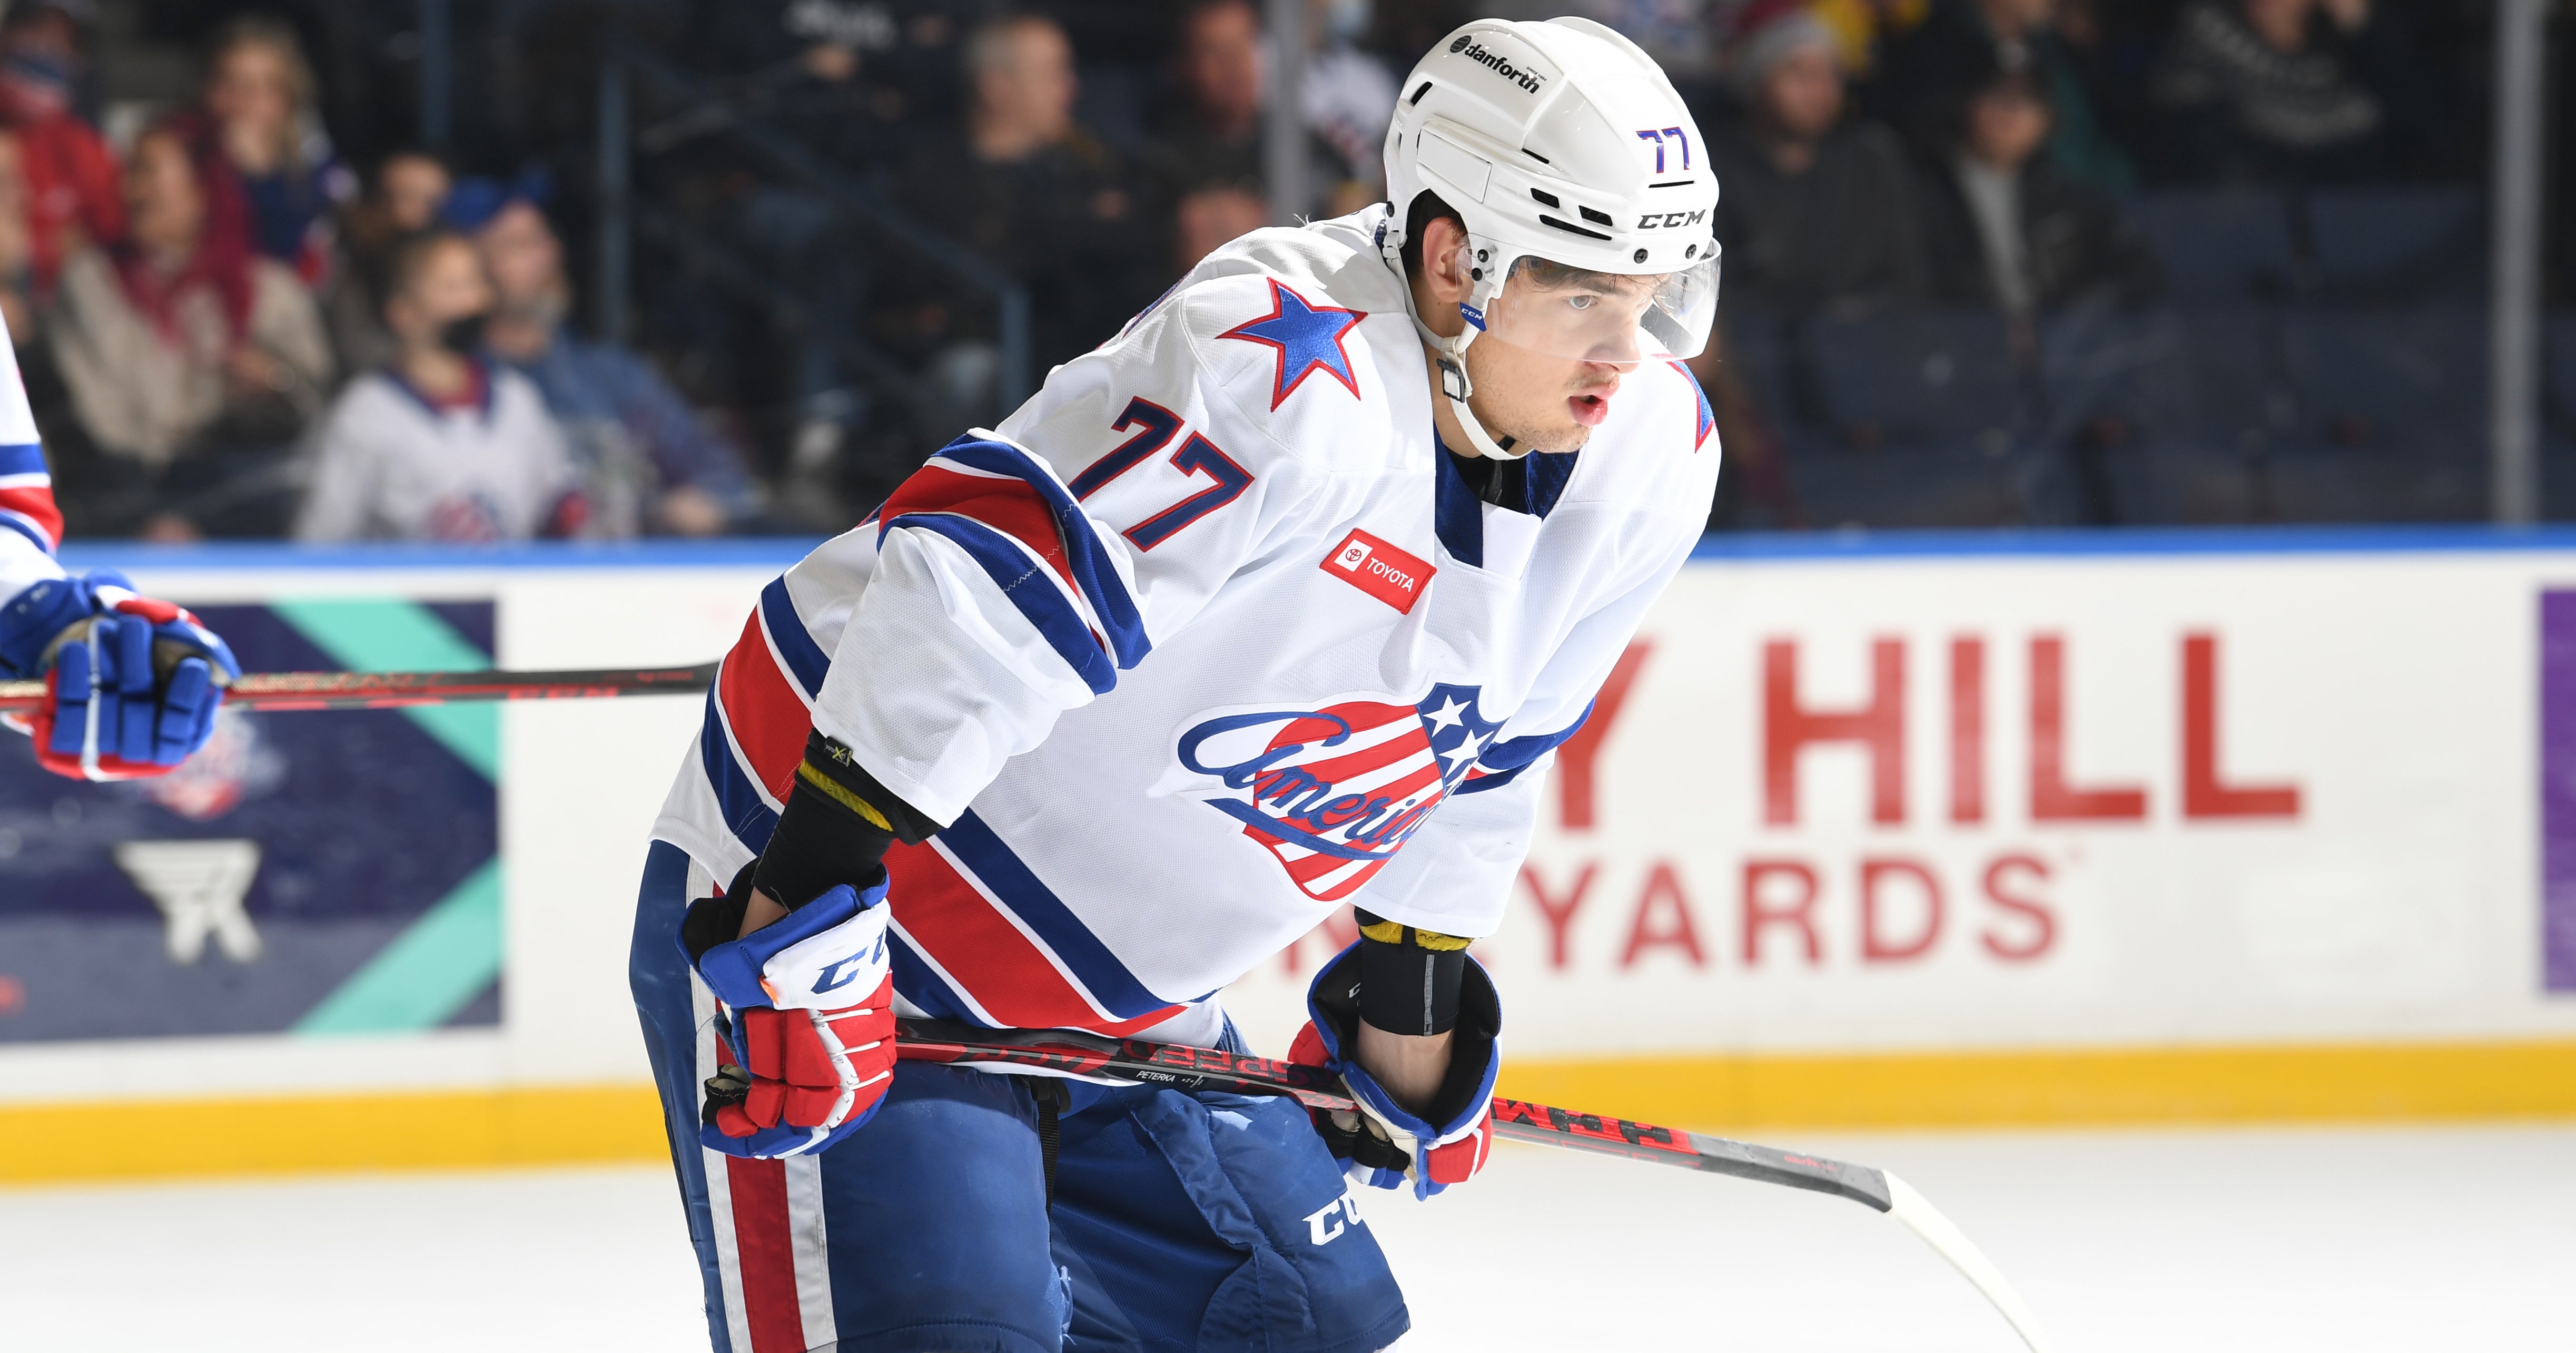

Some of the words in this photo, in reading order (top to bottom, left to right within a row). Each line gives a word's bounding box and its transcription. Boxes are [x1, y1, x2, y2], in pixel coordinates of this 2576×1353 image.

[1464, 44, 1539, 94] danforth
[1636, 126, 1690, 173] 77
[1637, 209, 1706, 229] CCM
[1461, 308, 1482, 320] CCM
[1067, 396, 1255, 553] 77
[1367, 557, 1414, 592] TOYOTA
[1761, 632, 2302, 825] HILL
[1280, 857, 2054, 979] YARDS
[1122, 1040, 1310, 1085] SPEED
[1136, 1071, 1176, 1082] PETERKA
